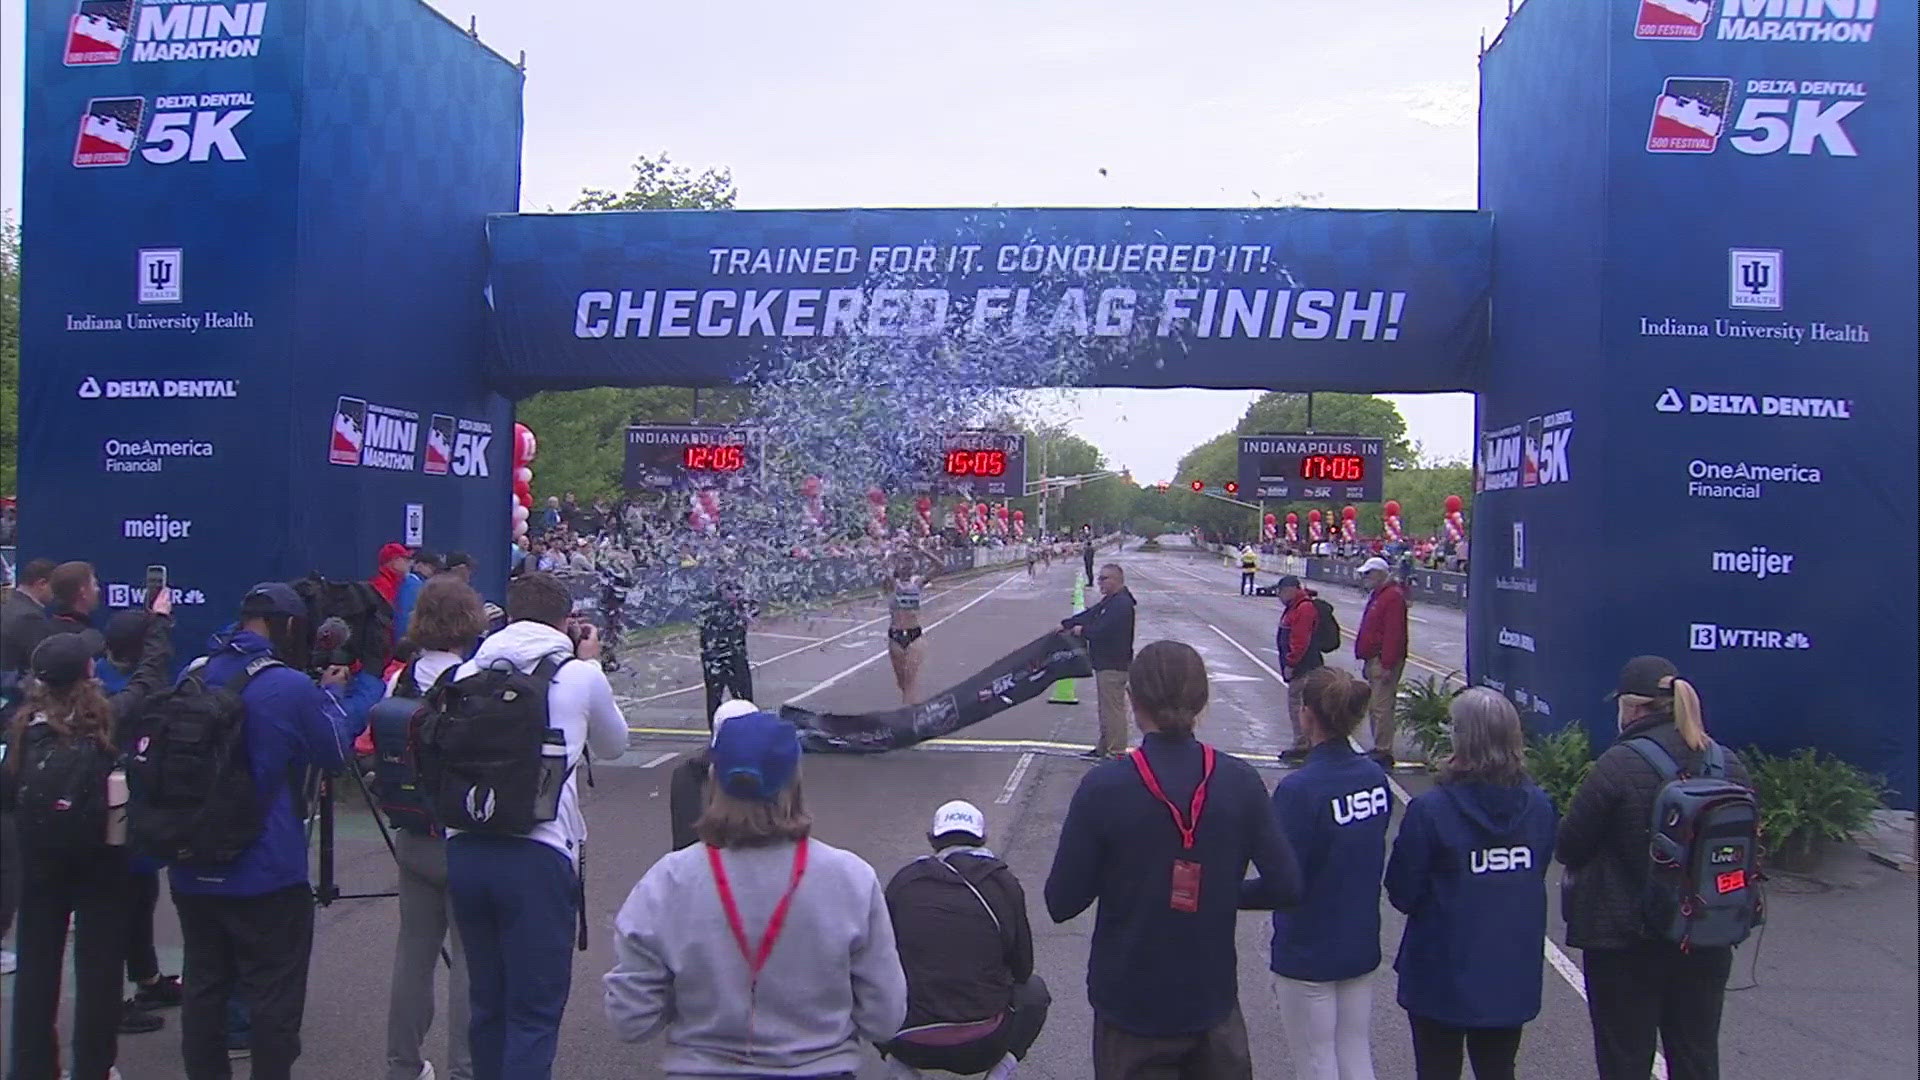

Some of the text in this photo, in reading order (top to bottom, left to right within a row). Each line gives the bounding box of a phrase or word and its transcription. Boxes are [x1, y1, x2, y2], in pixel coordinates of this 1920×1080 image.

[136, 2, 267, 41] MINI
[1639, 24, 1698, 36] 500 FESTIVAL
[1717, 18, 1873, 42] MARATHON
[132, 38, 260, 62] MARATHON
[1746, 80, 1867, 96] DELTA DENTAL
[156, 93, 255, 108] DELTA DENTAL
[141, 109, 252, 164] 5K
[1729, 98, 1865, 156] 5K
[1651, 137, 1711, 149] 500 FESTIVAL
[709, 244, 1272, 274] TRAINED FOR IT. CONQUERED IT!
[1735, 295, 1777, 304] HEALTH
[66, 311, 254, 334] Indiana University Health
[575, 287, 1406, 342] CHECKERED FLAG FINISH!
[1640, 317, 1869, 345] Indiana University Health
[106, 380, 237, 398] DELTA DENTAL
[1689, 394, 1850, 419] DELTA DENTAL
[365, 413, 418, 453] MINI
[105, 439, 213, 456] OneAmerica
[362, 447, 415, 472] MARATHON
[452, 433, 492, 477] 5K
[1362, 443, 1378, 455] IN
[1539, 428, 1573, 485] 5K
[106, 458, 162, 472] Financial
[1688, 460, 1821, 482] OneAmerica
[1689, 481, 1760, 499] Financial
[124, 514, 192, 543] meijer
[1712, 546, 1793, 579] meijer
[131, 588, 183, 604] WR
[1692, 626, 1782, 649] 13 WTHR
[1331, 787, 1388, 825] USA
[1471, 846, 1532, 873] USA
